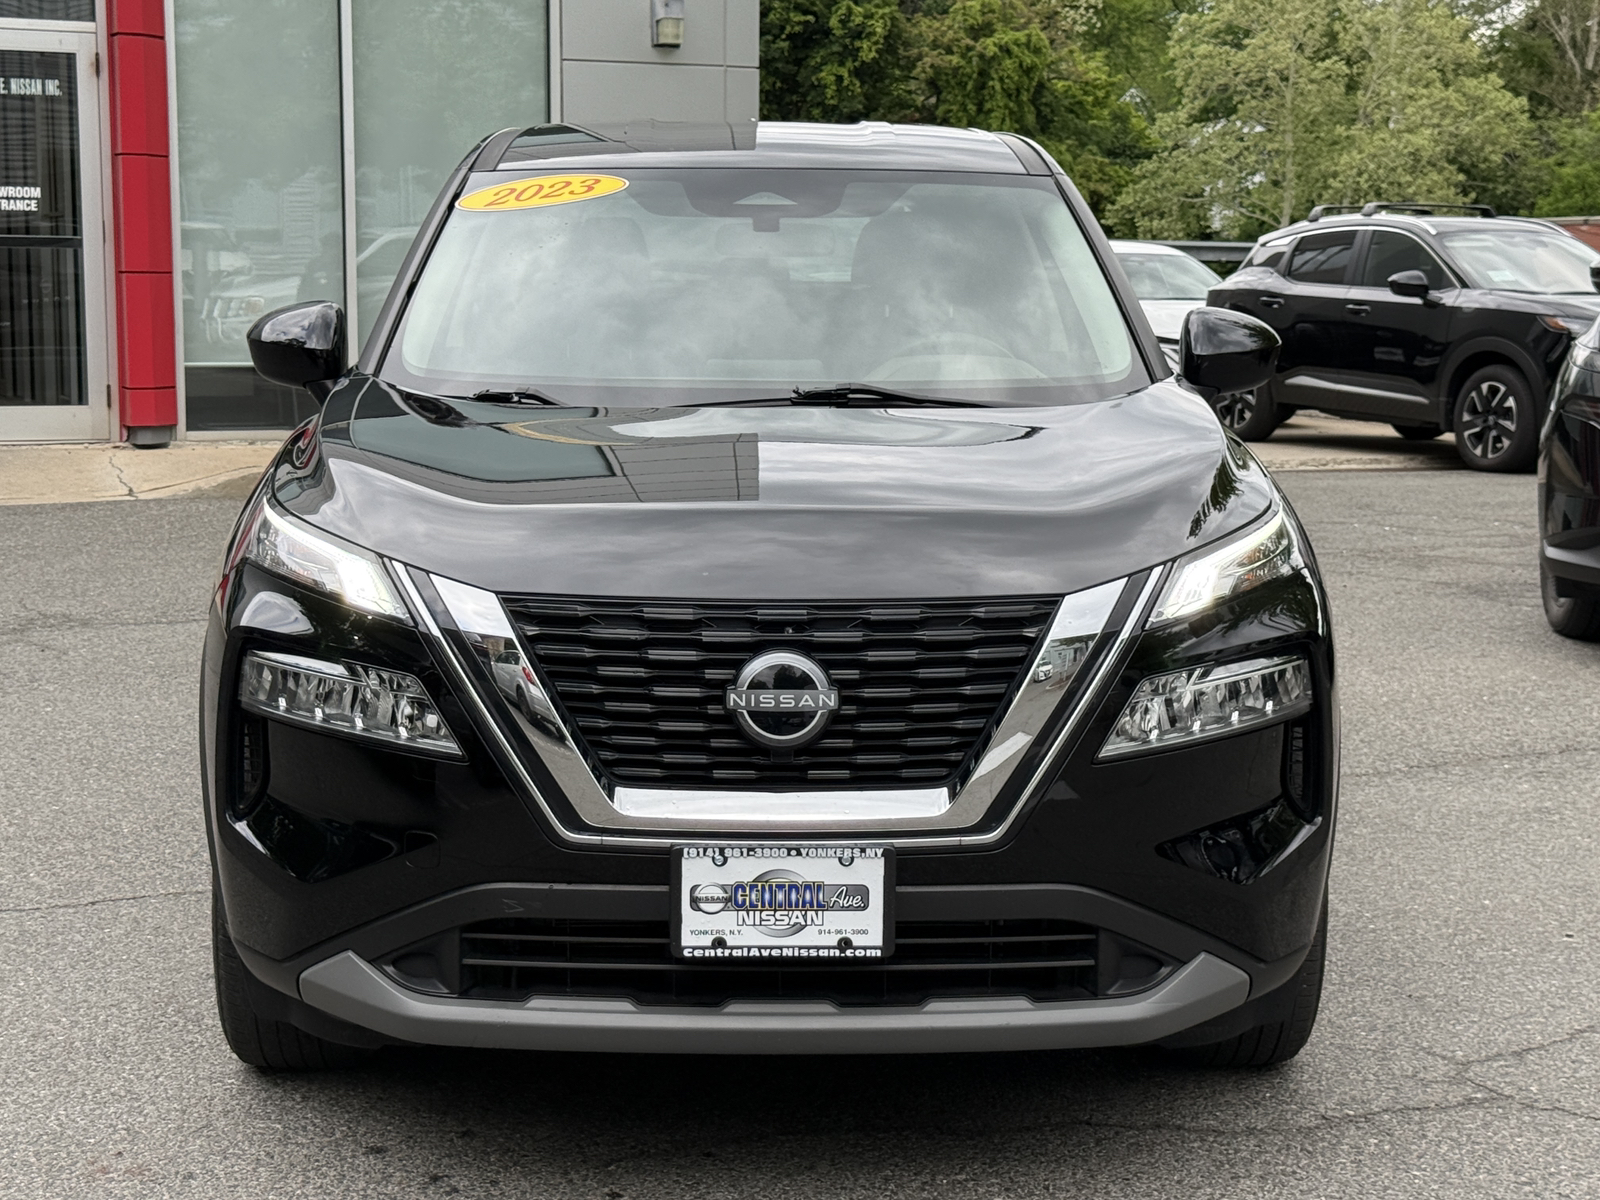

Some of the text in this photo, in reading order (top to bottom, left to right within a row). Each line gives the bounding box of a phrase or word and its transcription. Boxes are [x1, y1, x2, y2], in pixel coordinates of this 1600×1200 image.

[10, 77, 43, 96] NISSAN
[45, 78, 62, 97] INC.
[484, 179, 602, 208] 2023
[0, 199, 39, 211] RANCE
[729, 693, 835, 708] NISSAN
[724, 847, 787, 858] 961-3900
[695, 894, 727, 902] NISSAN
[732, 881, 865, 910] CENTRAL Ave.
[736, 910, 824, 926] NISSAN
[689, 929, 728, 937] YONKERS,
[817, 928, 869, 936] 914-961-3900
[682, 946, 882, 957] CentralAveNissan.com
